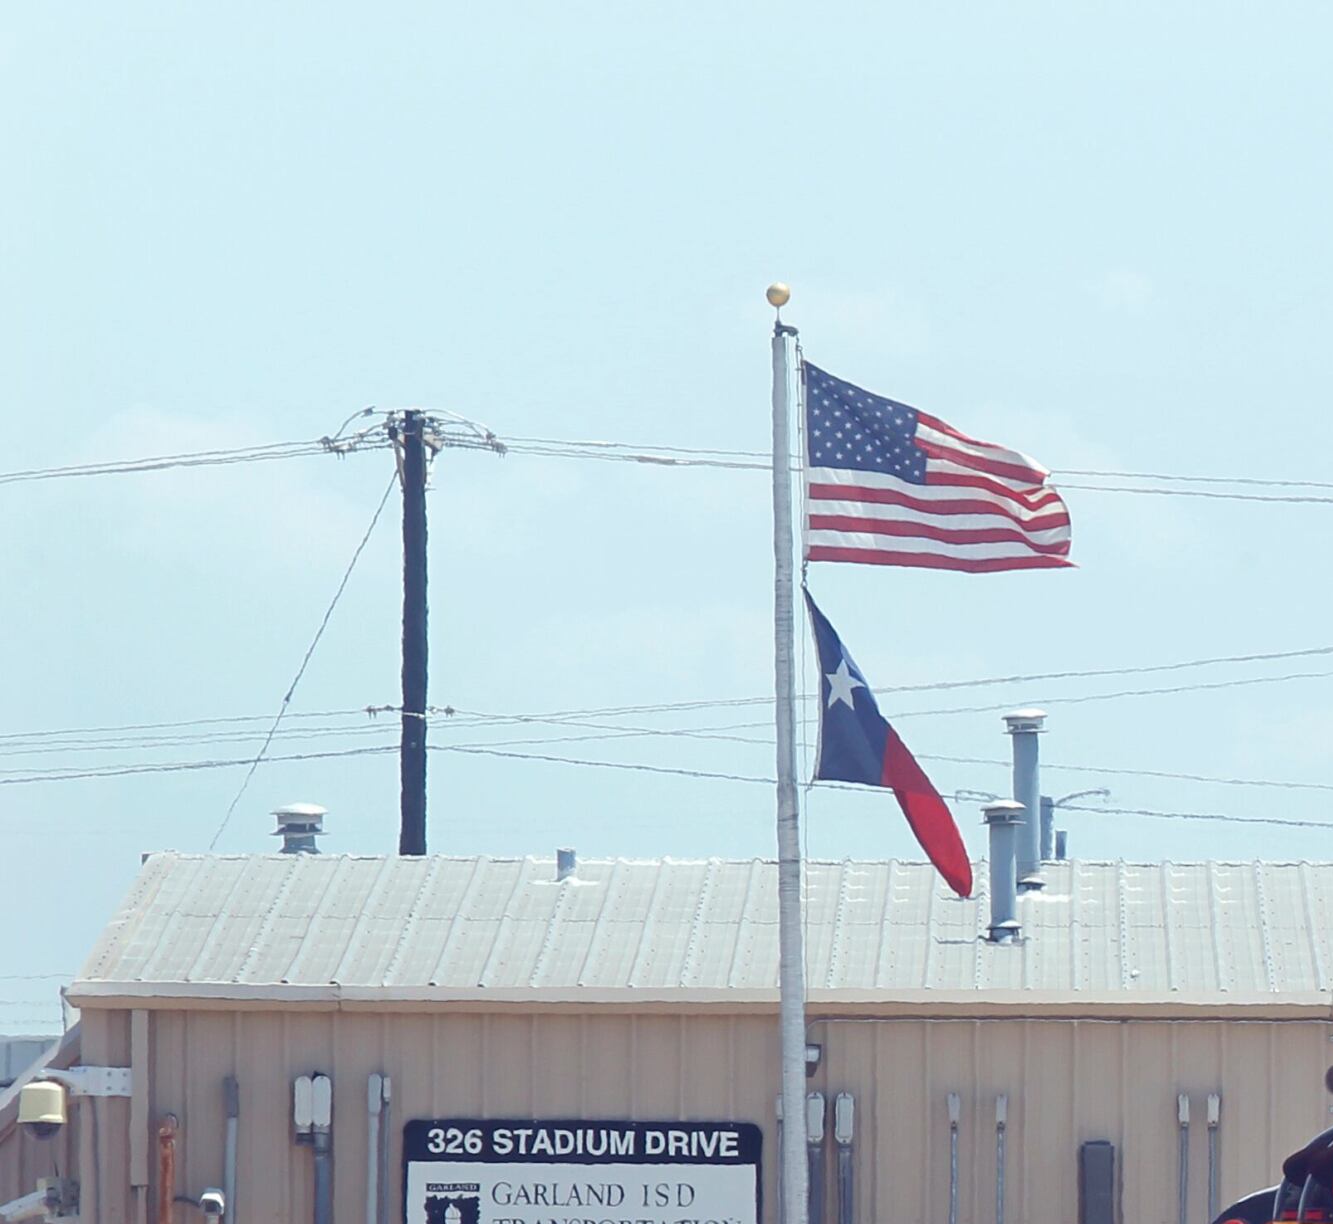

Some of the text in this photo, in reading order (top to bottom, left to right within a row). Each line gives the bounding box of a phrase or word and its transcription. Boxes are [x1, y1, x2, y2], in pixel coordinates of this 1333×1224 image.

[427, 1127, 740, 1158] 326 STADIUM DRIVE
[491, 1181, 626, 1208] GARLAND
